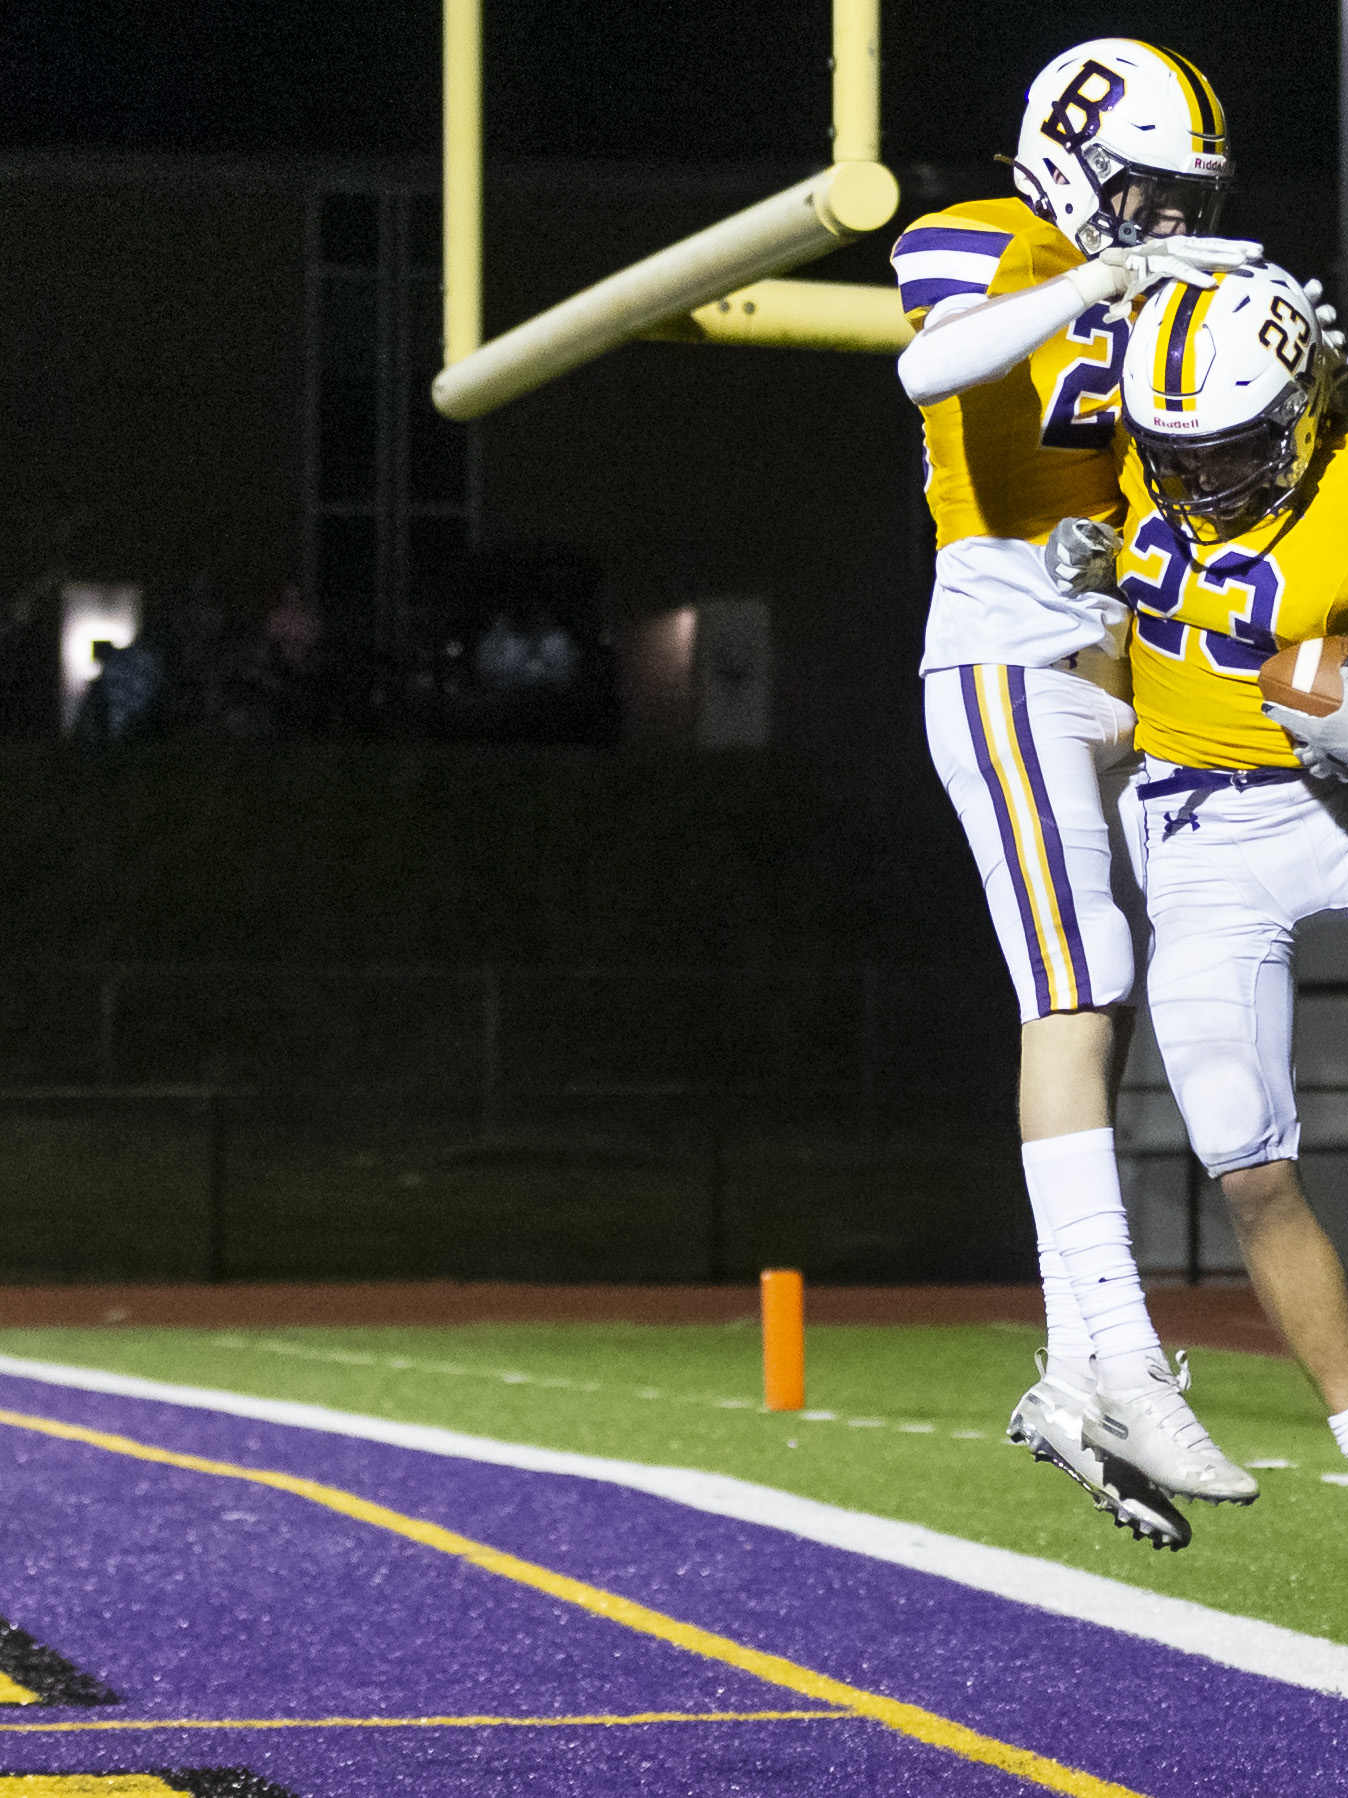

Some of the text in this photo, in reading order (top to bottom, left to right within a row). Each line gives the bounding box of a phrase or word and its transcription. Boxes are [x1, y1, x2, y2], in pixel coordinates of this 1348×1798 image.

[1040, 59, 1127, 148] B
[1259, 295, 1311, 377] 23
[1118, 509, 1286, 677] 23
